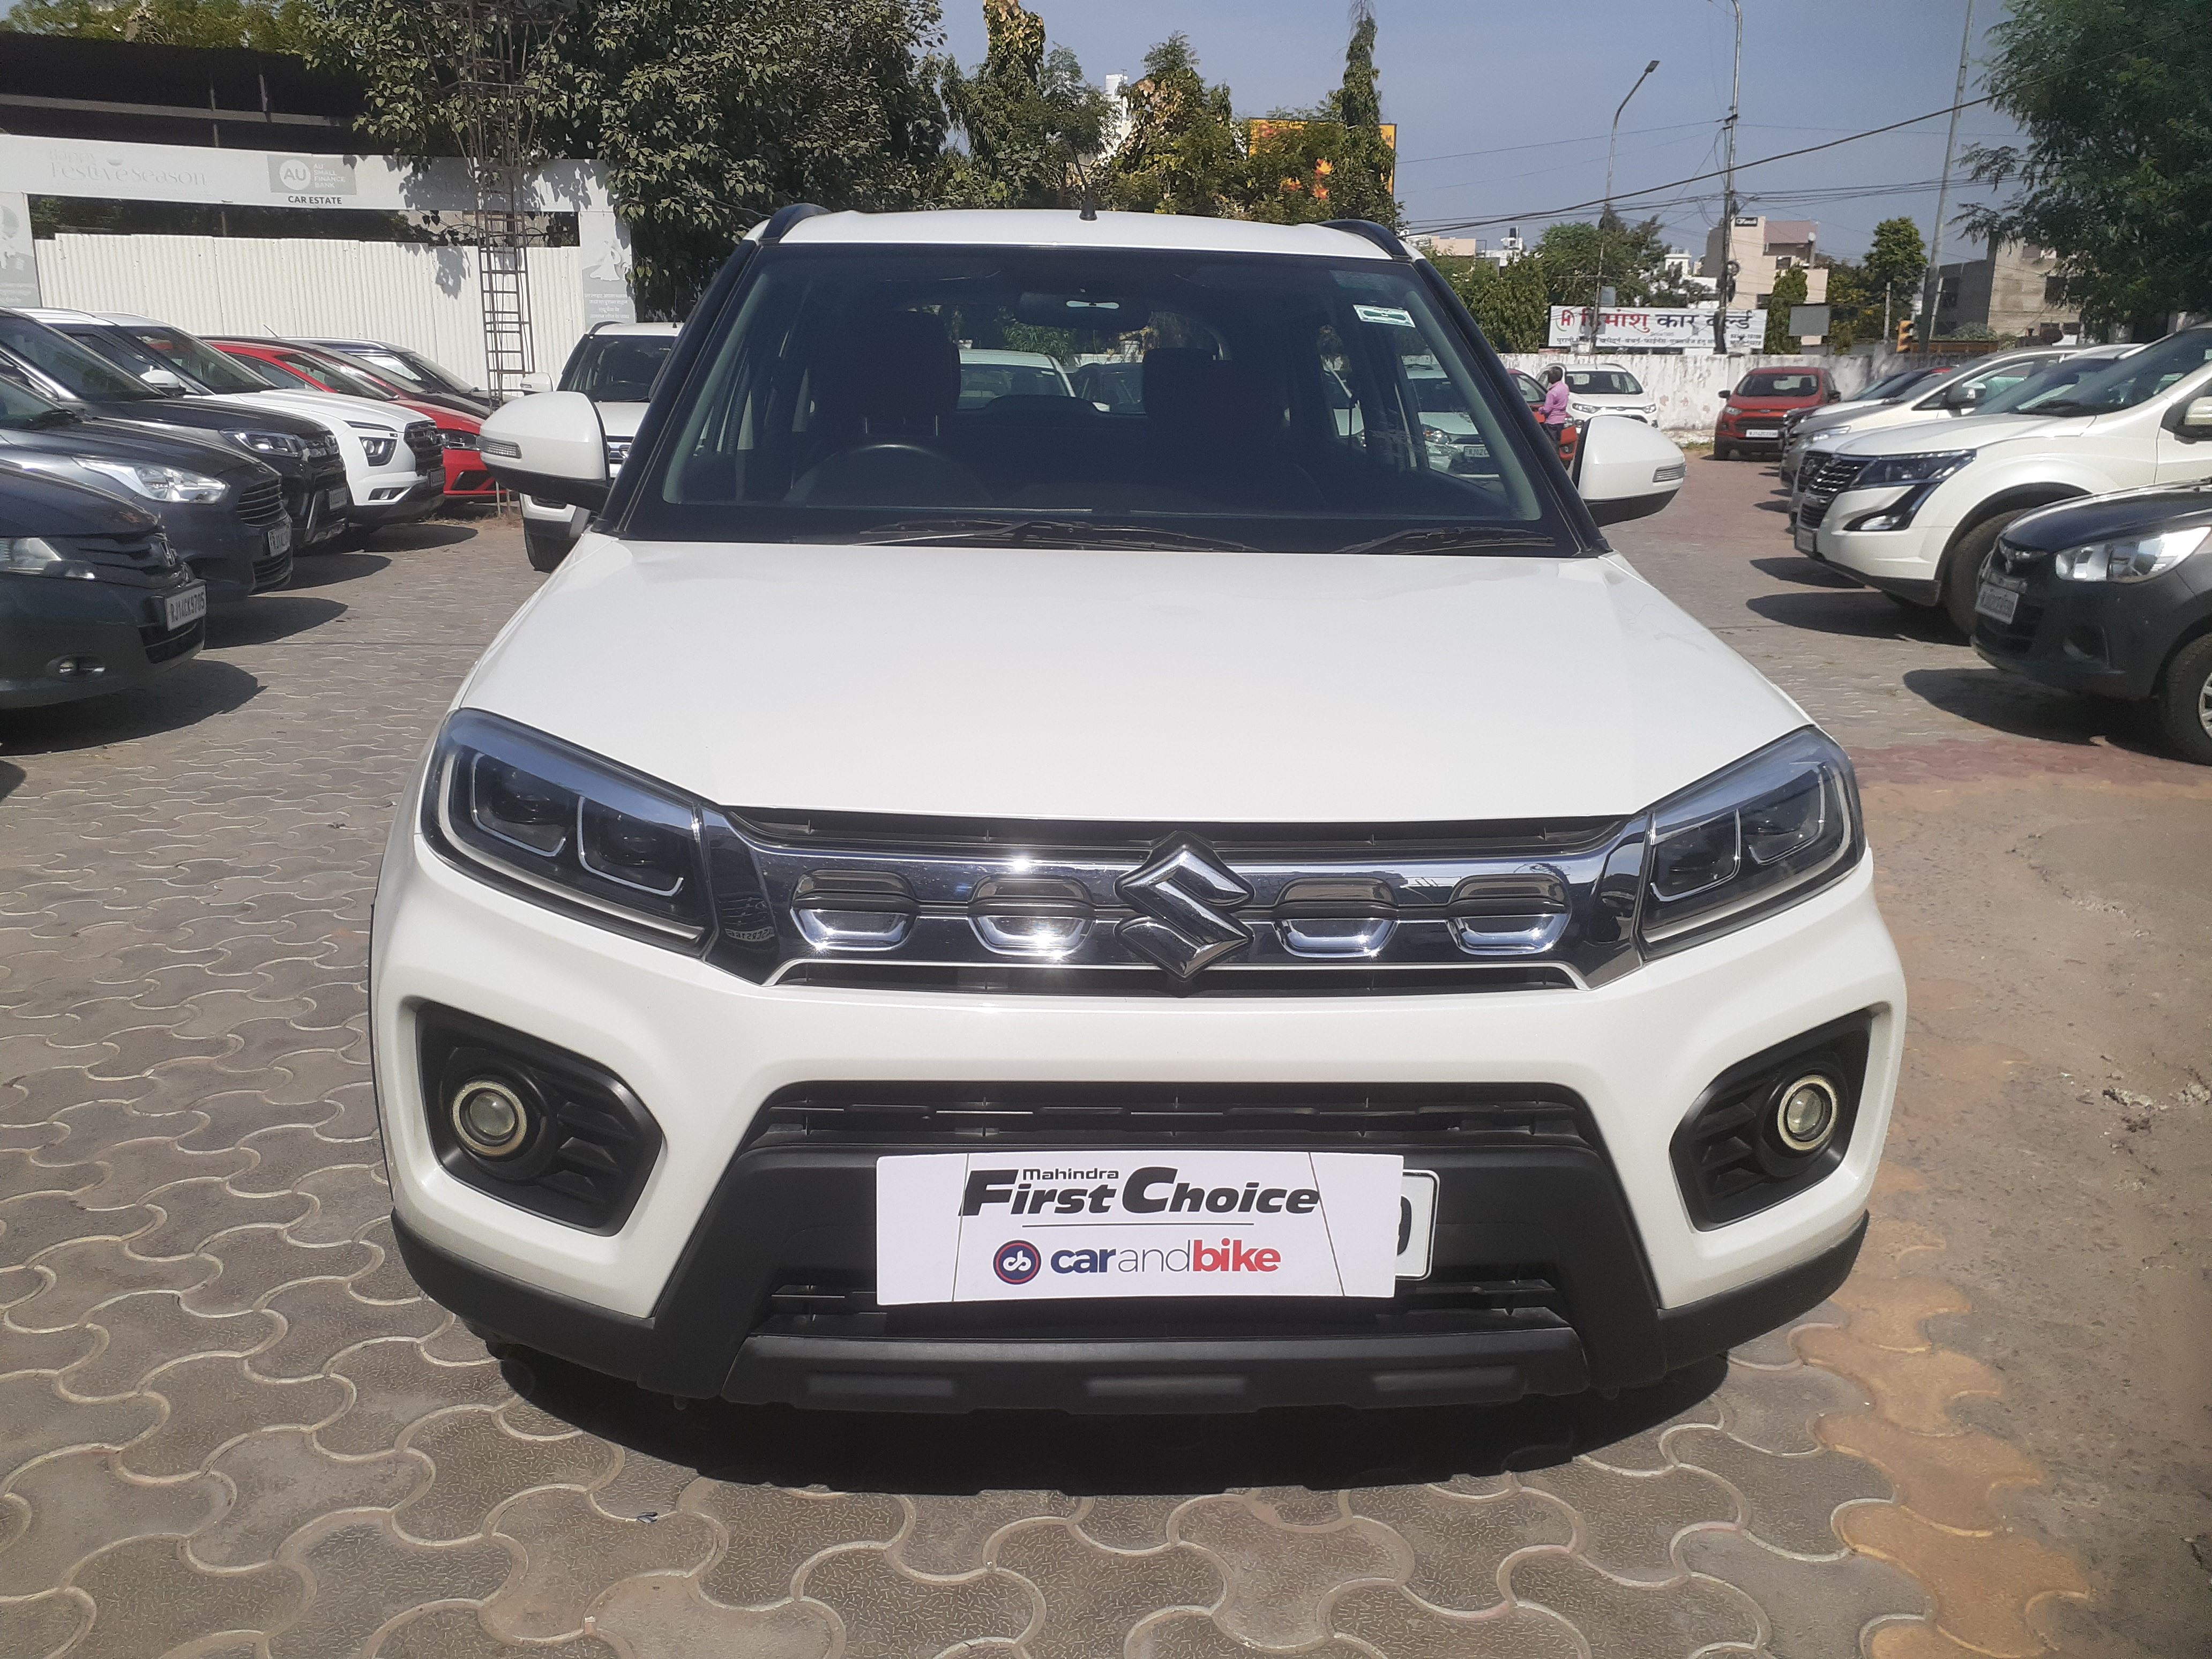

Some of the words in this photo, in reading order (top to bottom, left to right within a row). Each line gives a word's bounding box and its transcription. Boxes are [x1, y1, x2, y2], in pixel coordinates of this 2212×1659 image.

[283, 168, 306, 181] AU
[288, 196, 307, 204] CAR
[309, 197, 342, 205] ESTATE
[1023, 1168, 1119, 1180] Mahindra
[958, 1169, 1117, 1216] First
[1122, 1167, 1319, 1214] Choice
